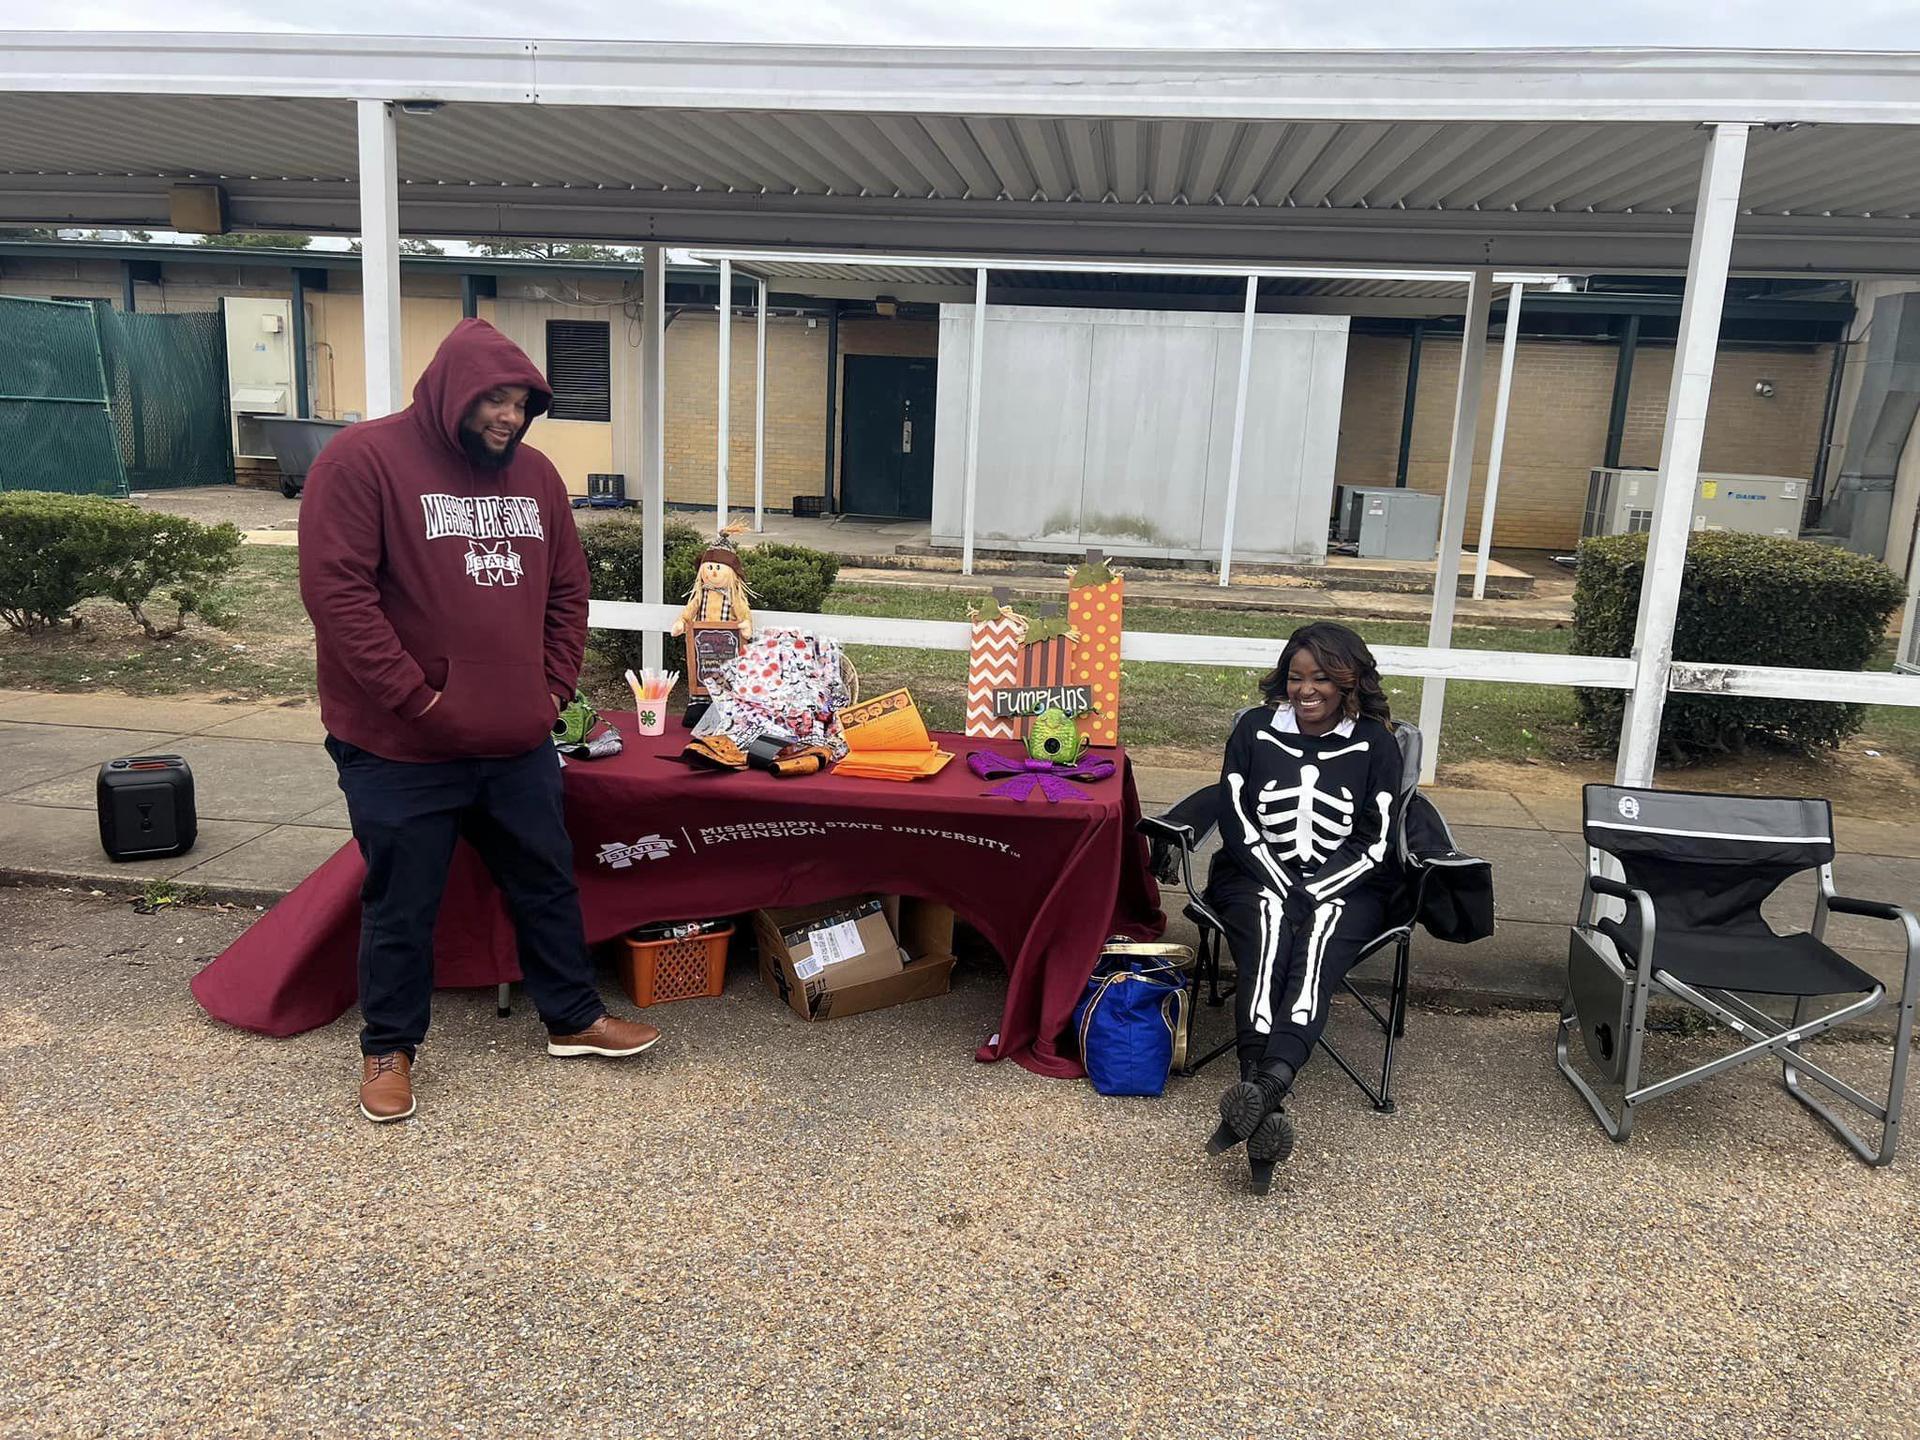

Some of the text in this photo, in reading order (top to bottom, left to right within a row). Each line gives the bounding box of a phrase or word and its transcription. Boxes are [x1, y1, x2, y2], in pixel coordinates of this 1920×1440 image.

[503, 497, 544, 541] STATE
[476, 555, 512, 569] STATE
[699, 821, 816, 836] MISSISSIPPI
[825, 821, 883, 831] STATE
[892, 826, 1010, 853] UNIVERSITY
[702, 827, 826, 845] EXTENSION
[609, 843, 663, 860] STATE
